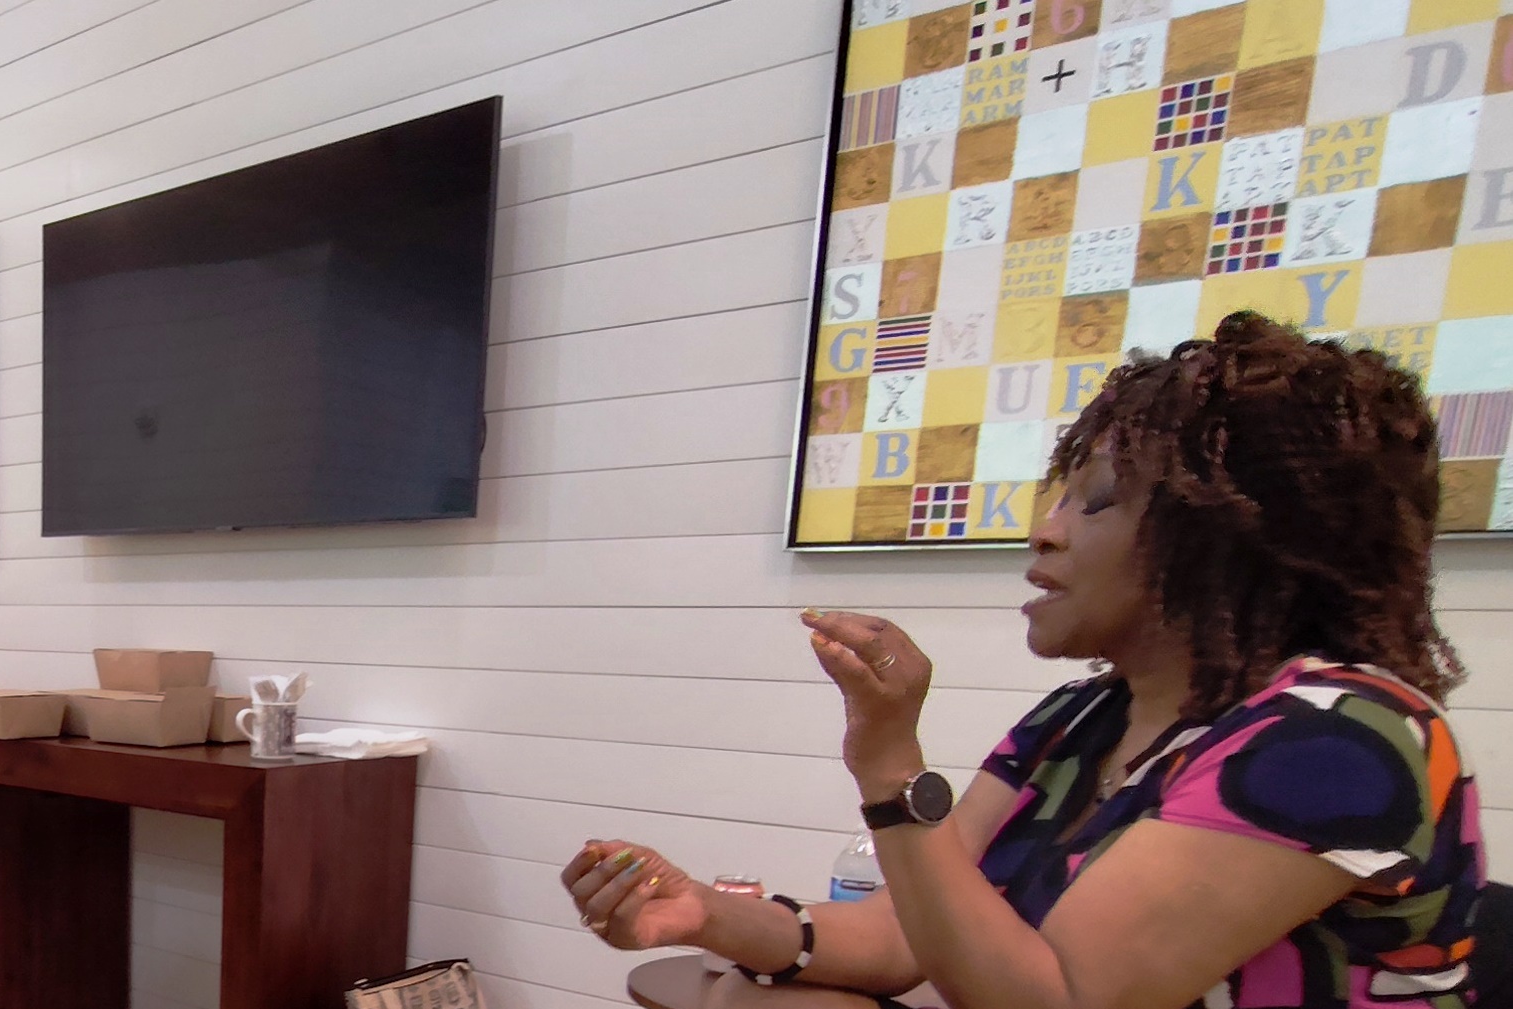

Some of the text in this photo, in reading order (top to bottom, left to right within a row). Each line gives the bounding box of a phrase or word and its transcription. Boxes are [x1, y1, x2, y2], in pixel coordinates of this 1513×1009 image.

[968, 57, 1030, 85] RAM
[1093, 34, 1153, 98] H
[1396, 40, 1468, 109] D
[965, 100, 1024, 123] ARM
[966, 79, 1026, 103] MAR
[1307, 117, 1383, 147] PAT
[896, 138, 942, 194] K
[1152, 151, 1207, 210] K
[1298, 169, 1373, 198] APT
[1300, 146, 1376, 174] TAP
[1006, 237, 1066, 255] ABCD
[830, 273, 865, 320] S
[1296, 270, 1350, 328] Y
[828, 328, 867, 373] G
[818, 382, 851, 429] 9
[877, 375, 915, 423] X
[996, 365, 1040, 415] U
[872, 432, 911, 479] B
[977, 483, 1022, 529] K
